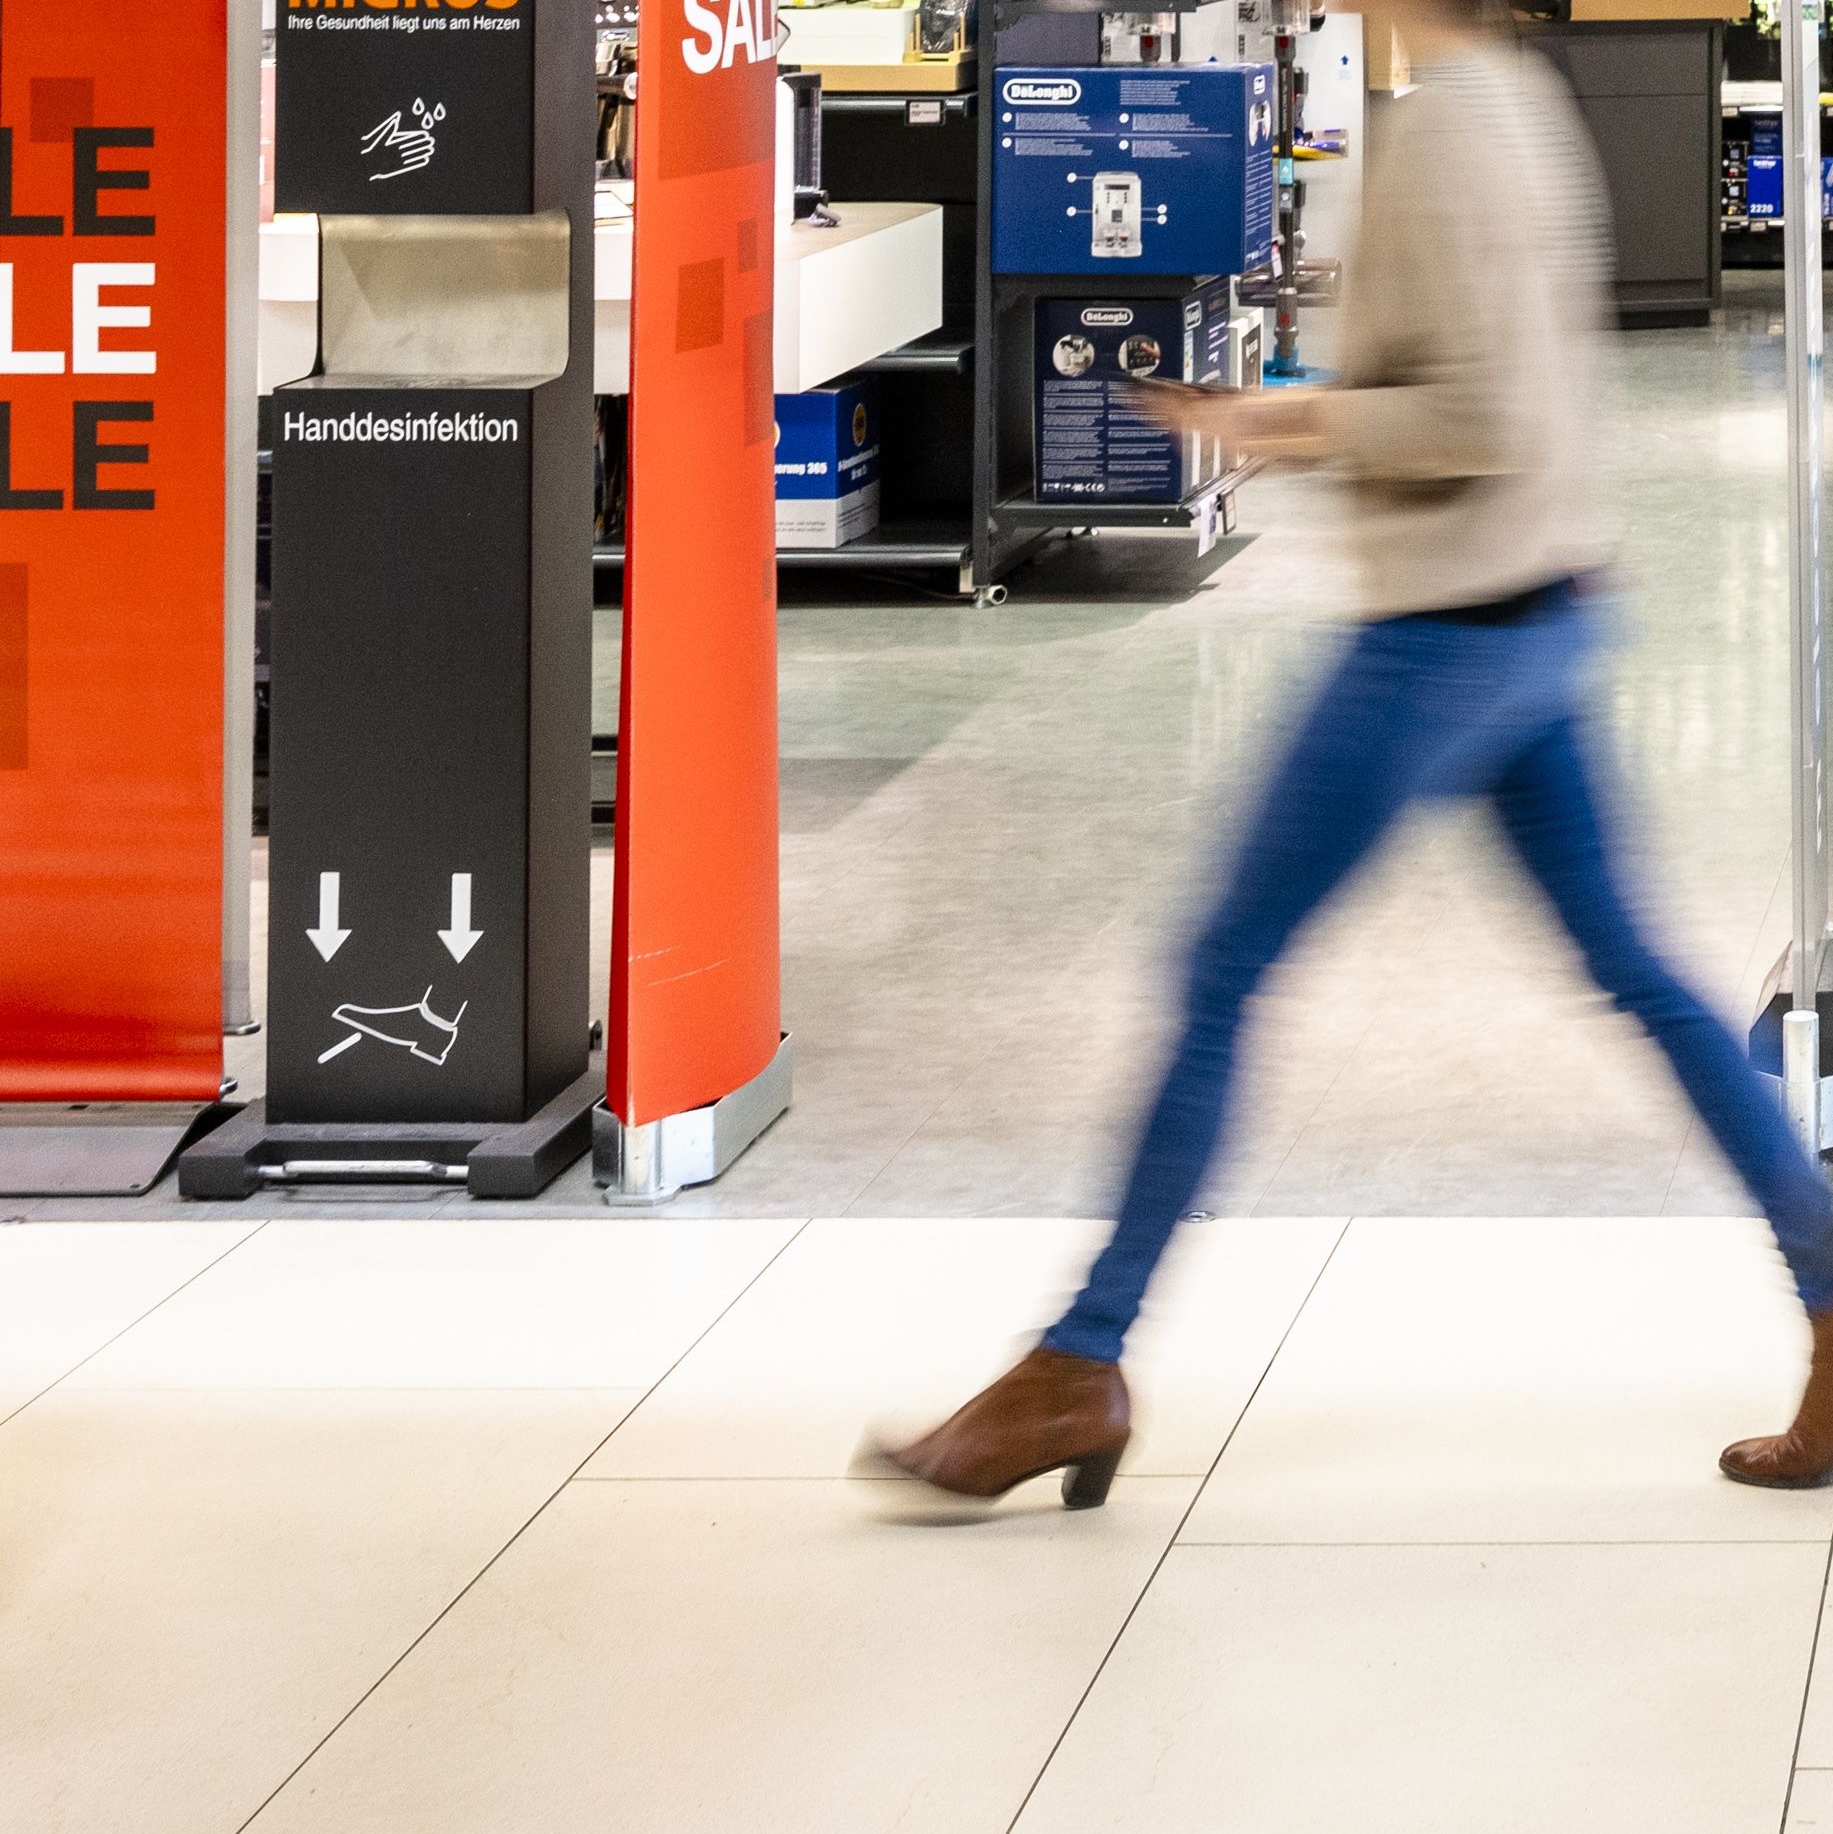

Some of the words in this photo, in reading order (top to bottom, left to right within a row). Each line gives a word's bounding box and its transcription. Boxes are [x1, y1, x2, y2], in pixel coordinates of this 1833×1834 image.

[288, 15, 313, 30] Ihre
[316, 14, 390, 31] Gesundheit
[392, 14, 420, 34] liegt
[422, 18, 447, 30] uns
[450, 18, 471, 30] am
[473, 15, 521, 31] Herzen
[283, 411, 519, 443] Handdesinfektion
